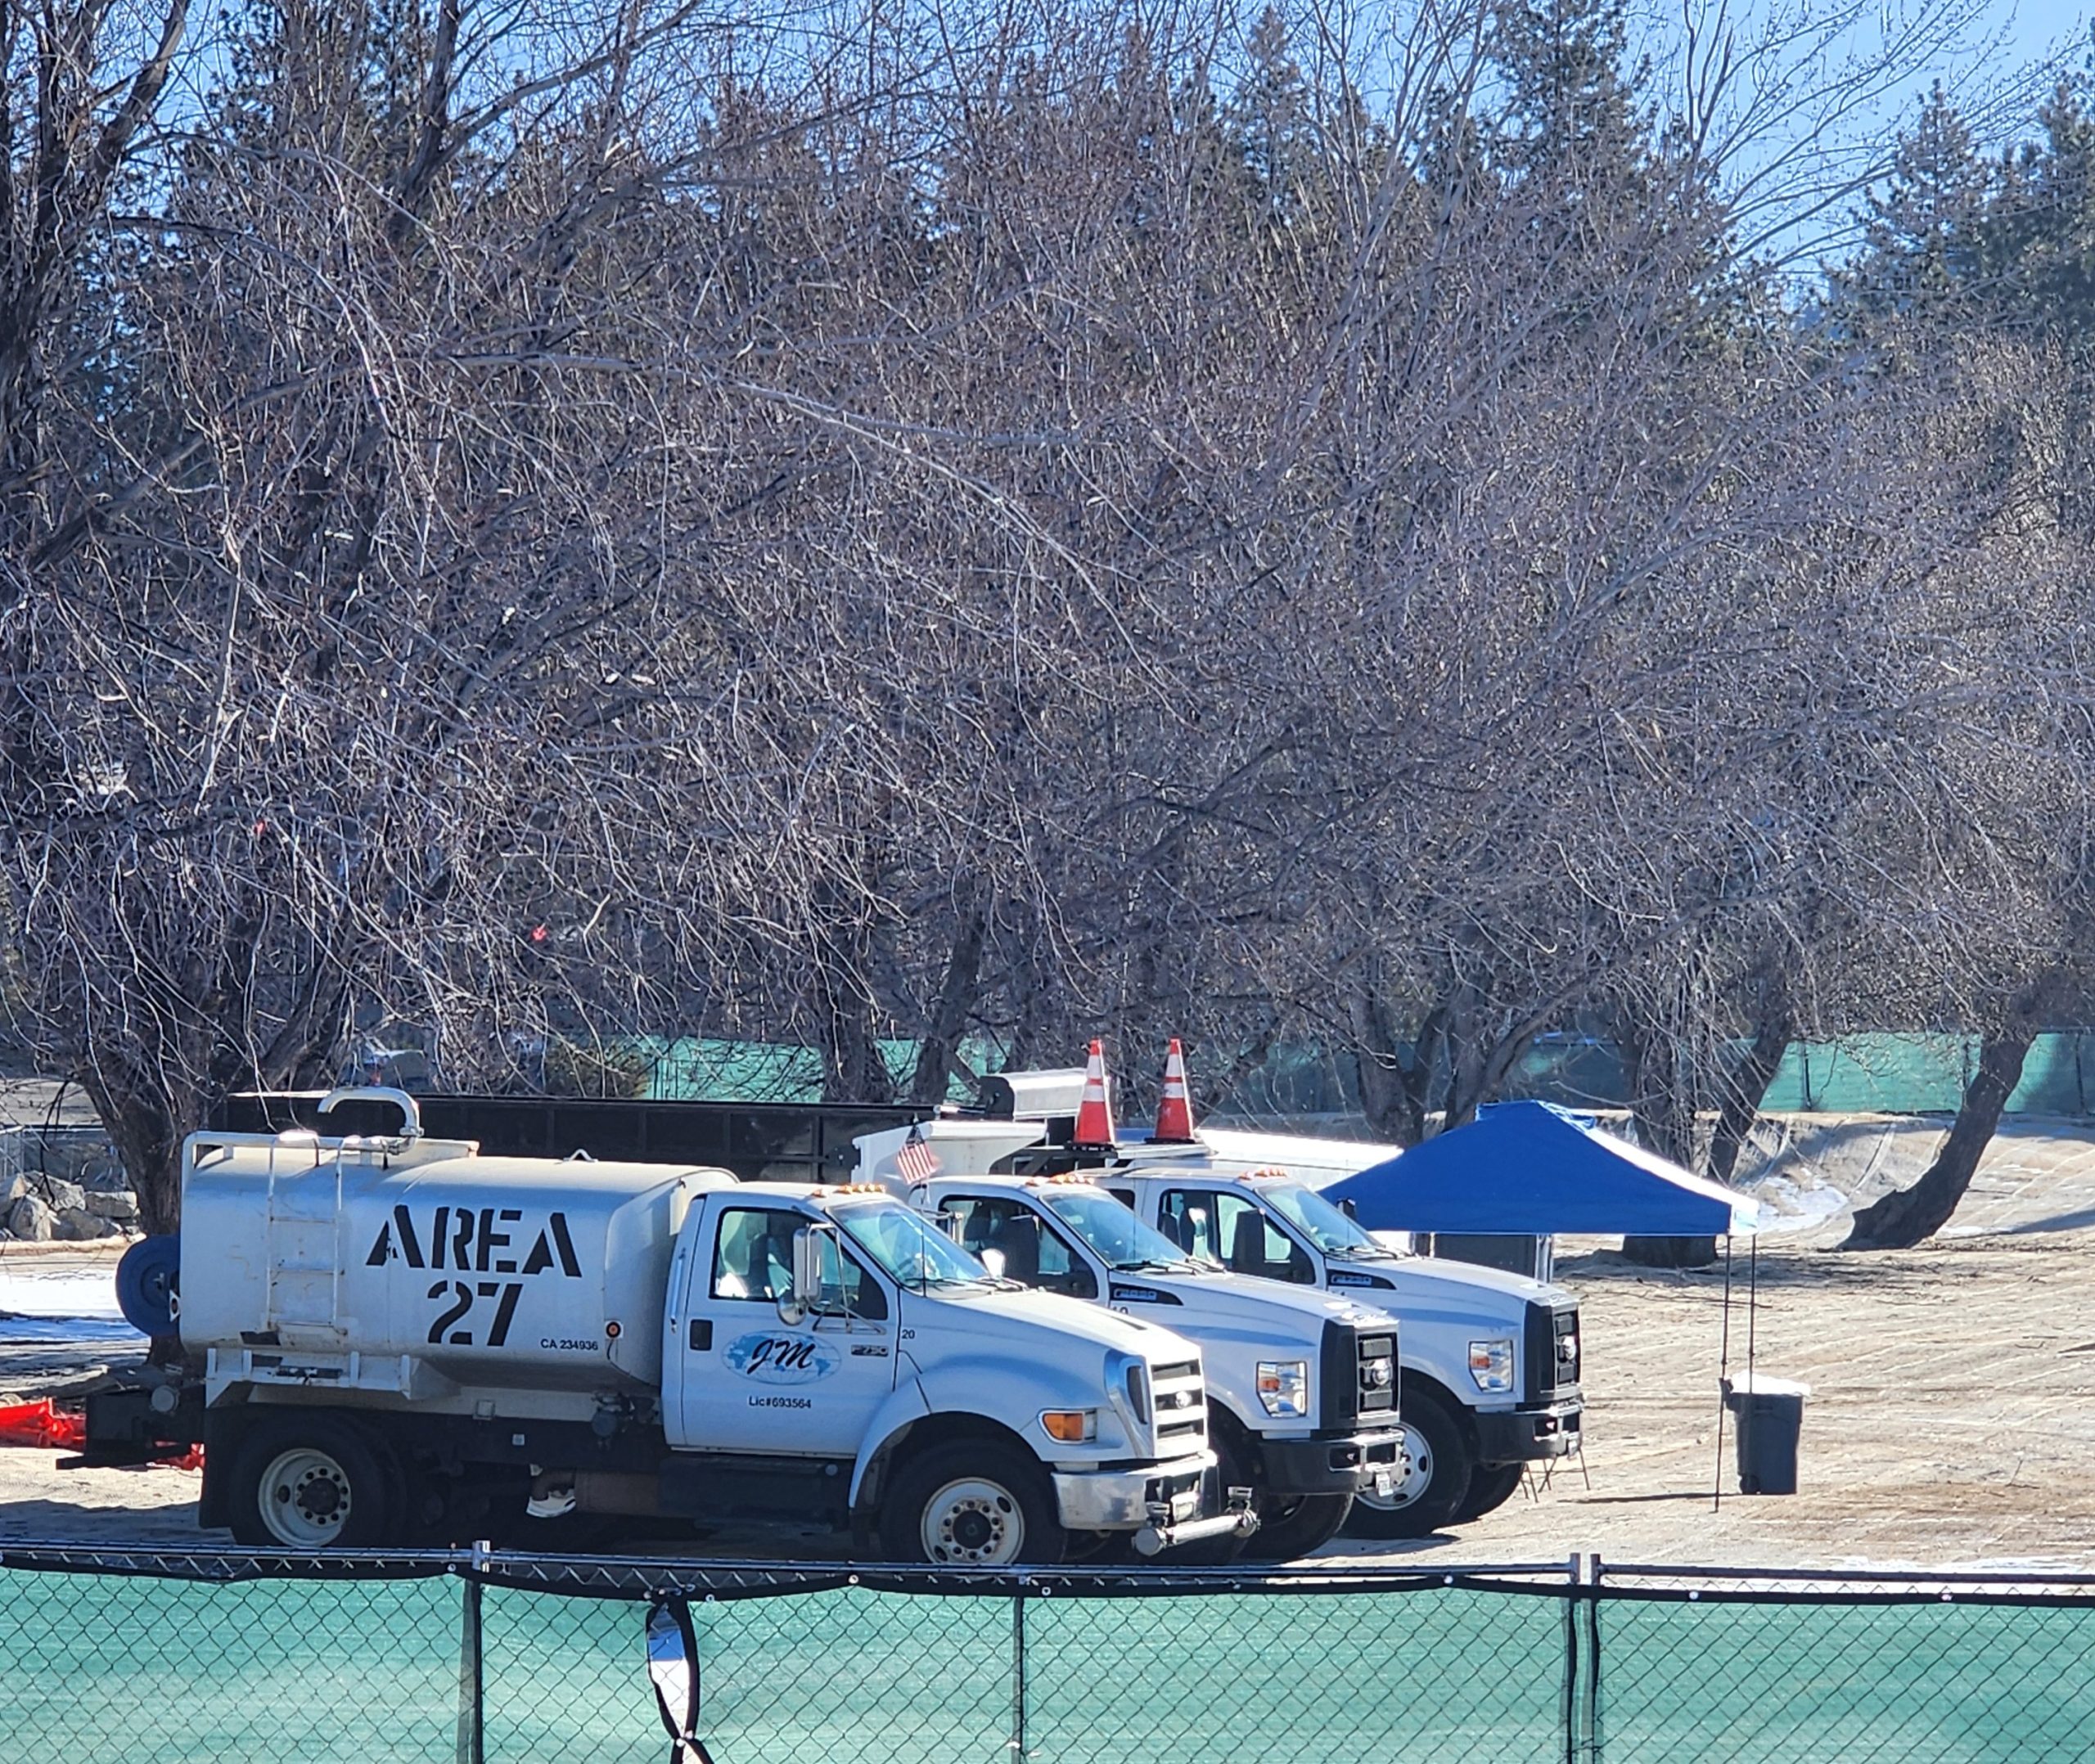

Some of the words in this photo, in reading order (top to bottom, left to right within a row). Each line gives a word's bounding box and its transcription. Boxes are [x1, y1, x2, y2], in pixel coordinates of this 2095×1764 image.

[366, 1204, 582, 1277] AREA
[427, 1280, 524, 1346] 27
[540, 1338, 558, 1349] CA
[559, 1339, 599, 1351] 234936
[901, 1329, 915, 1339] 20
[746, 1339, 816, 1375] JM
